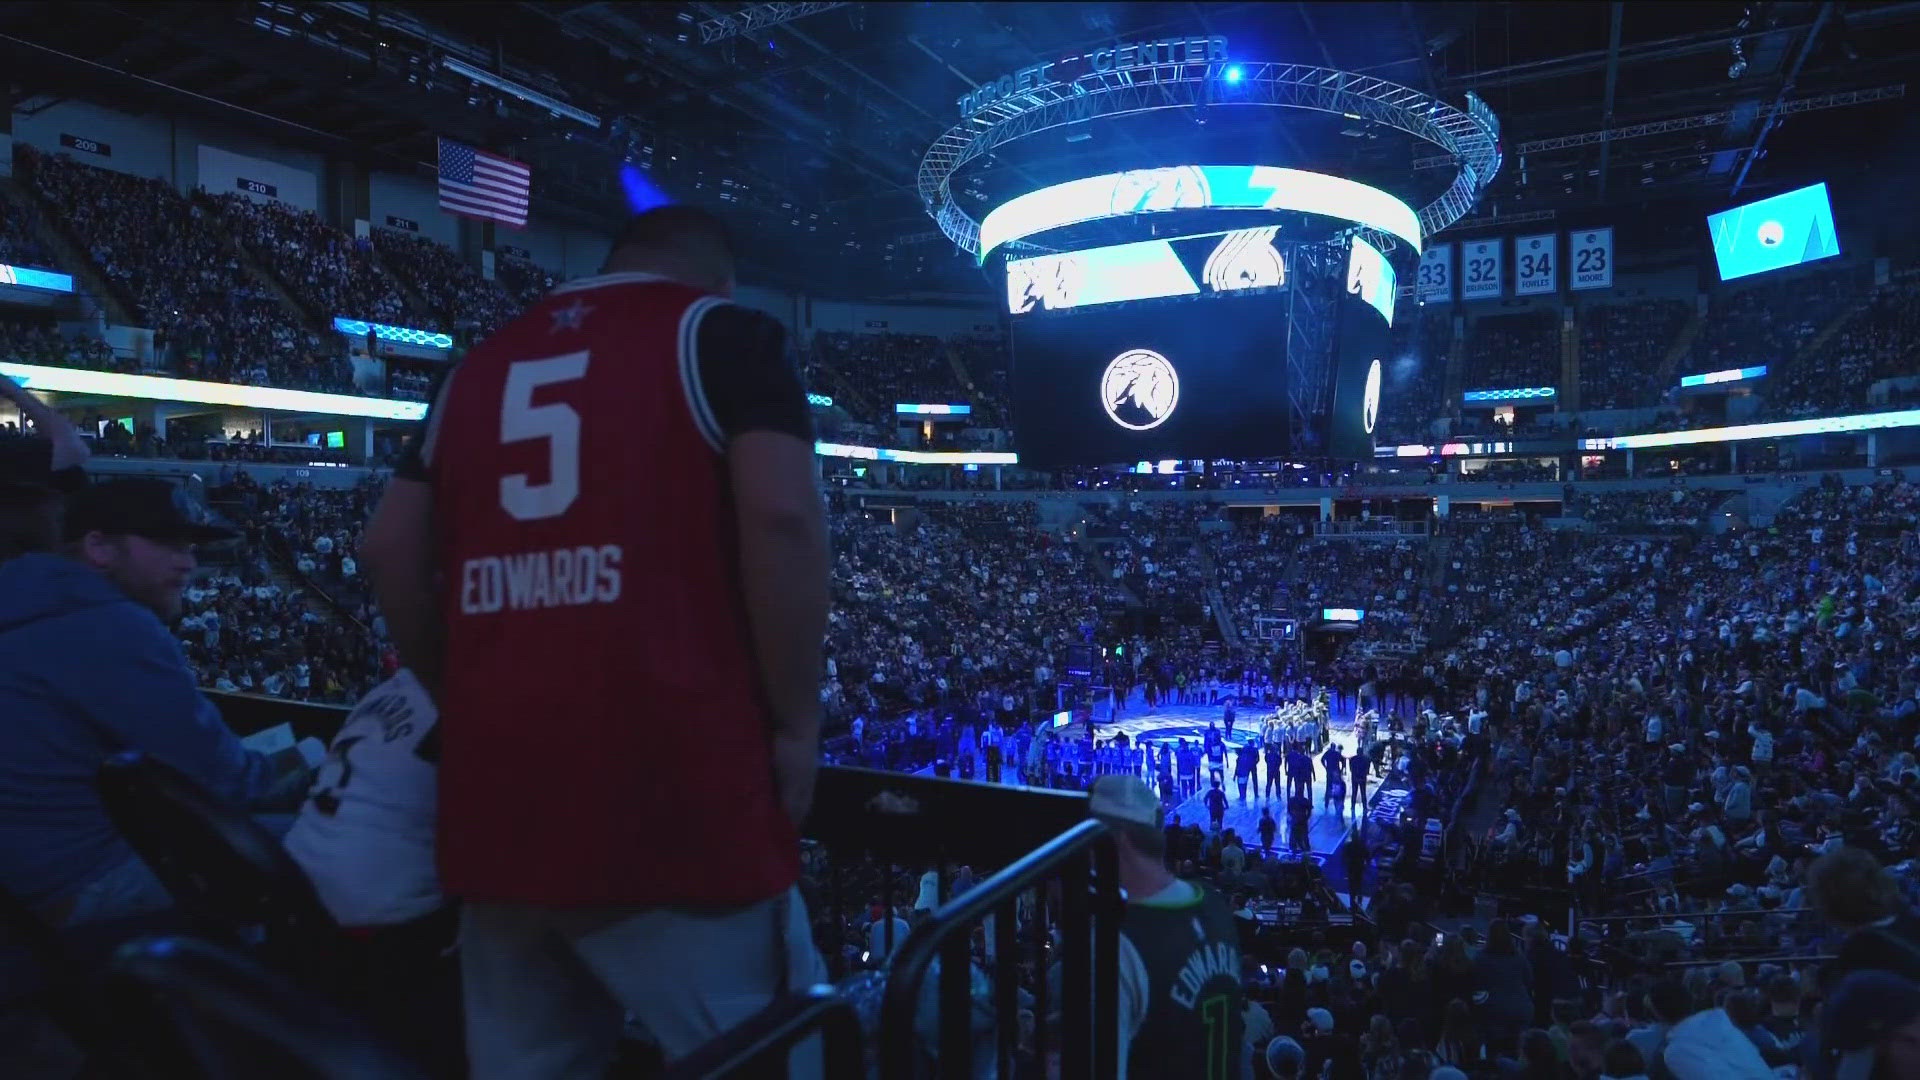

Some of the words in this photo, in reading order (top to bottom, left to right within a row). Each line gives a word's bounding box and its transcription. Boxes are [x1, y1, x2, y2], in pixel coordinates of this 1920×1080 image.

[1091, 34, 1229, 72] CENTER
[74, 138, 97, 152] 209
[248, 181, 266, 194] 210
[1468, 257, 1496, 283] 32
[1520, 253, 1551, 279] 34
[1577, 247, 1606, 273] 23
[1419, 263, 1446, 286] 33
[1521, 279, 1550, 289] FOWLES
[1578, 273, 1603, 282] MOORE
[499, 349, 591, 522] 5
[460, 543, 623, 616] EDWARDS
